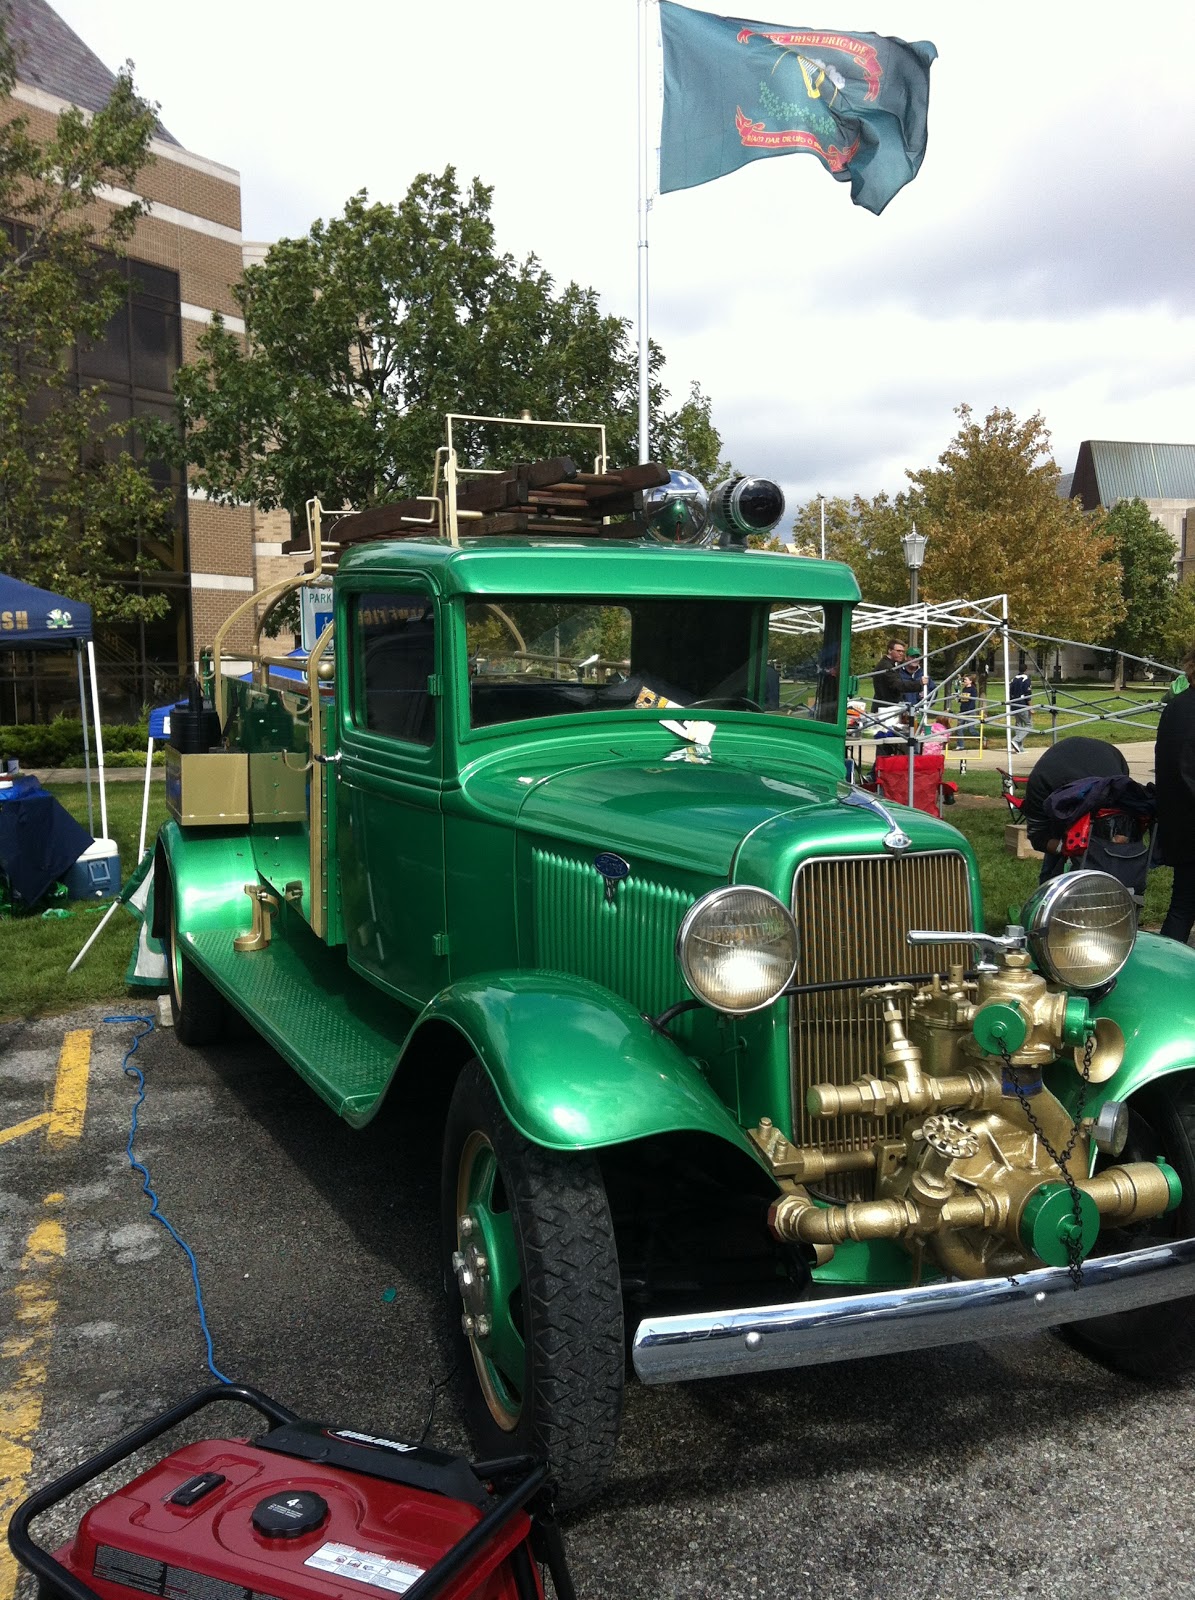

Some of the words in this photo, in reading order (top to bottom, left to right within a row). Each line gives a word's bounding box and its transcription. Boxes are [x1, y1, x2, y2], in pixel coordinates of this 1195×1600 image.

[790, 35, 819, 44] IRISH
[822, 36, 867, 53] BRIGADE
[309, 593, 332, 604] PARK
[0, 610, 29, 631] SH
